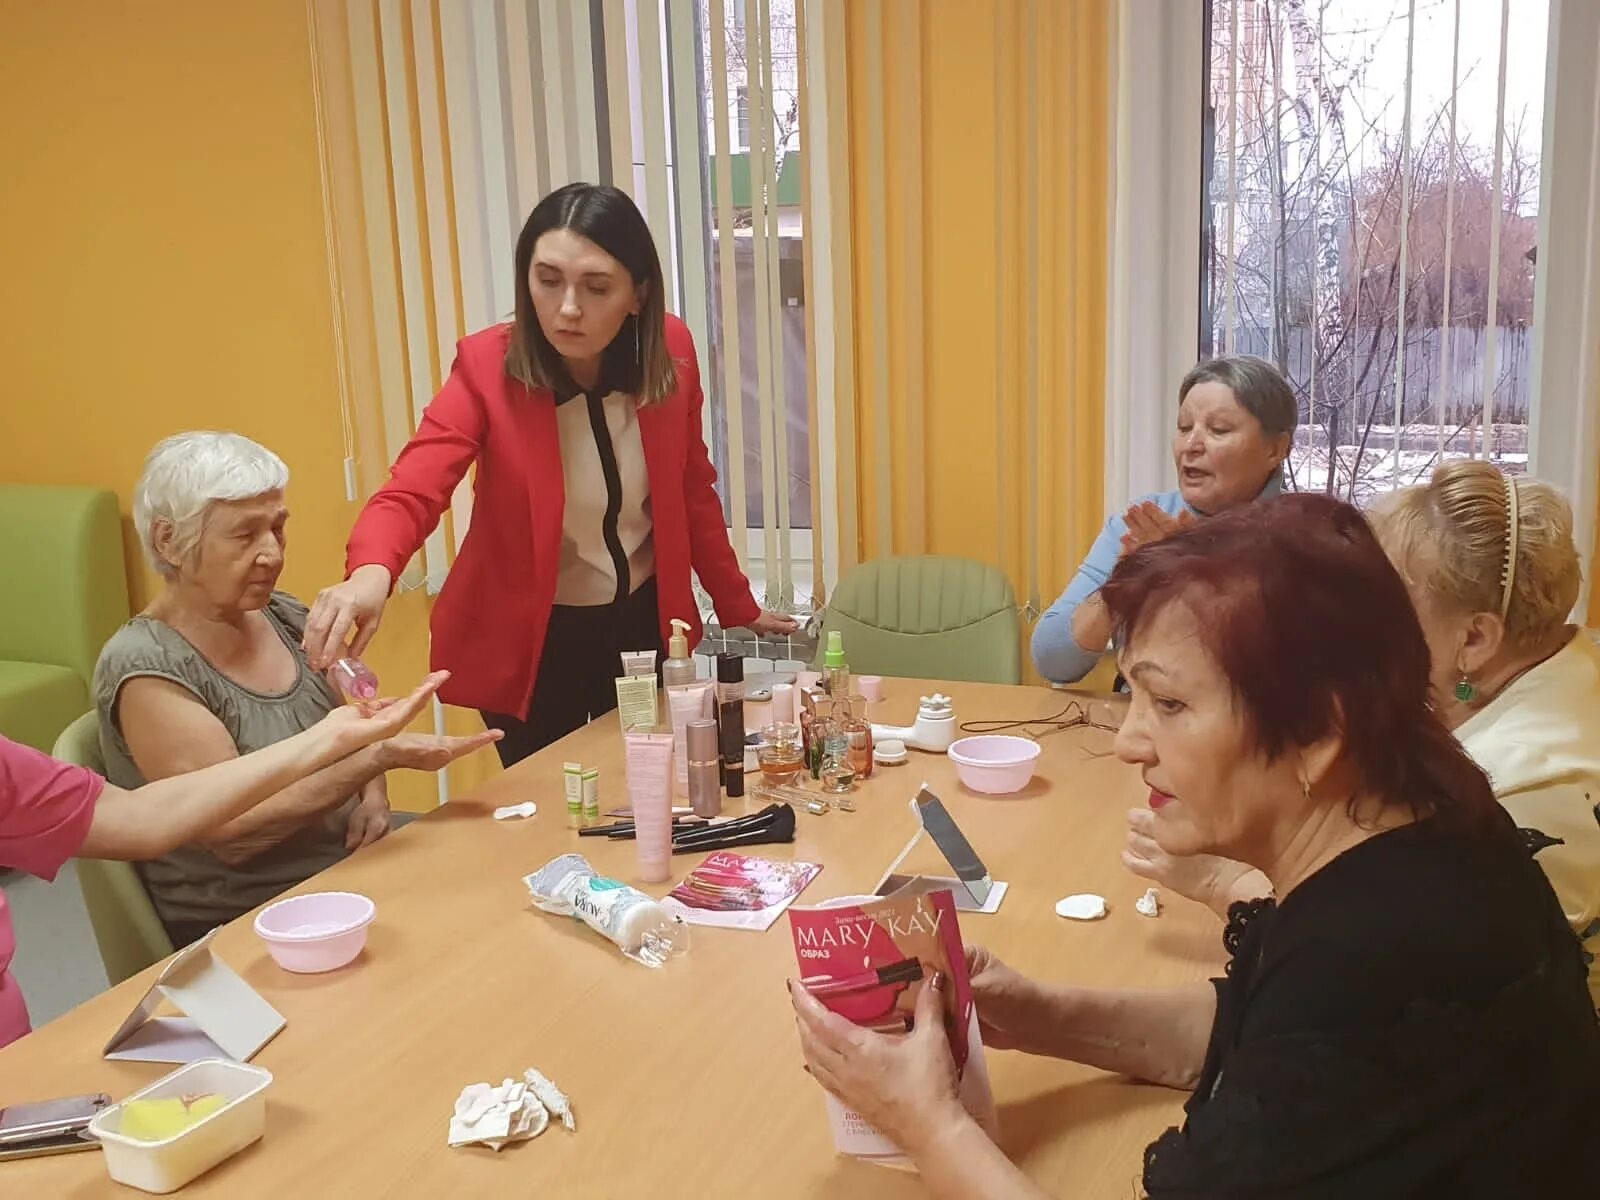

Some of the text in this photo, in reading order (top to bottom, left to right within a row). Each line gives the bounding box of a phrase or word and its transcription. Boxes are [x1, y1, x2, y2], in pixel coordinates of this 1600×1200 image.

[796, 920, 876, 949] MARY
[888, 908, 944, 937] KAY
[800, 948, 831, 959] ОБРАЗ
